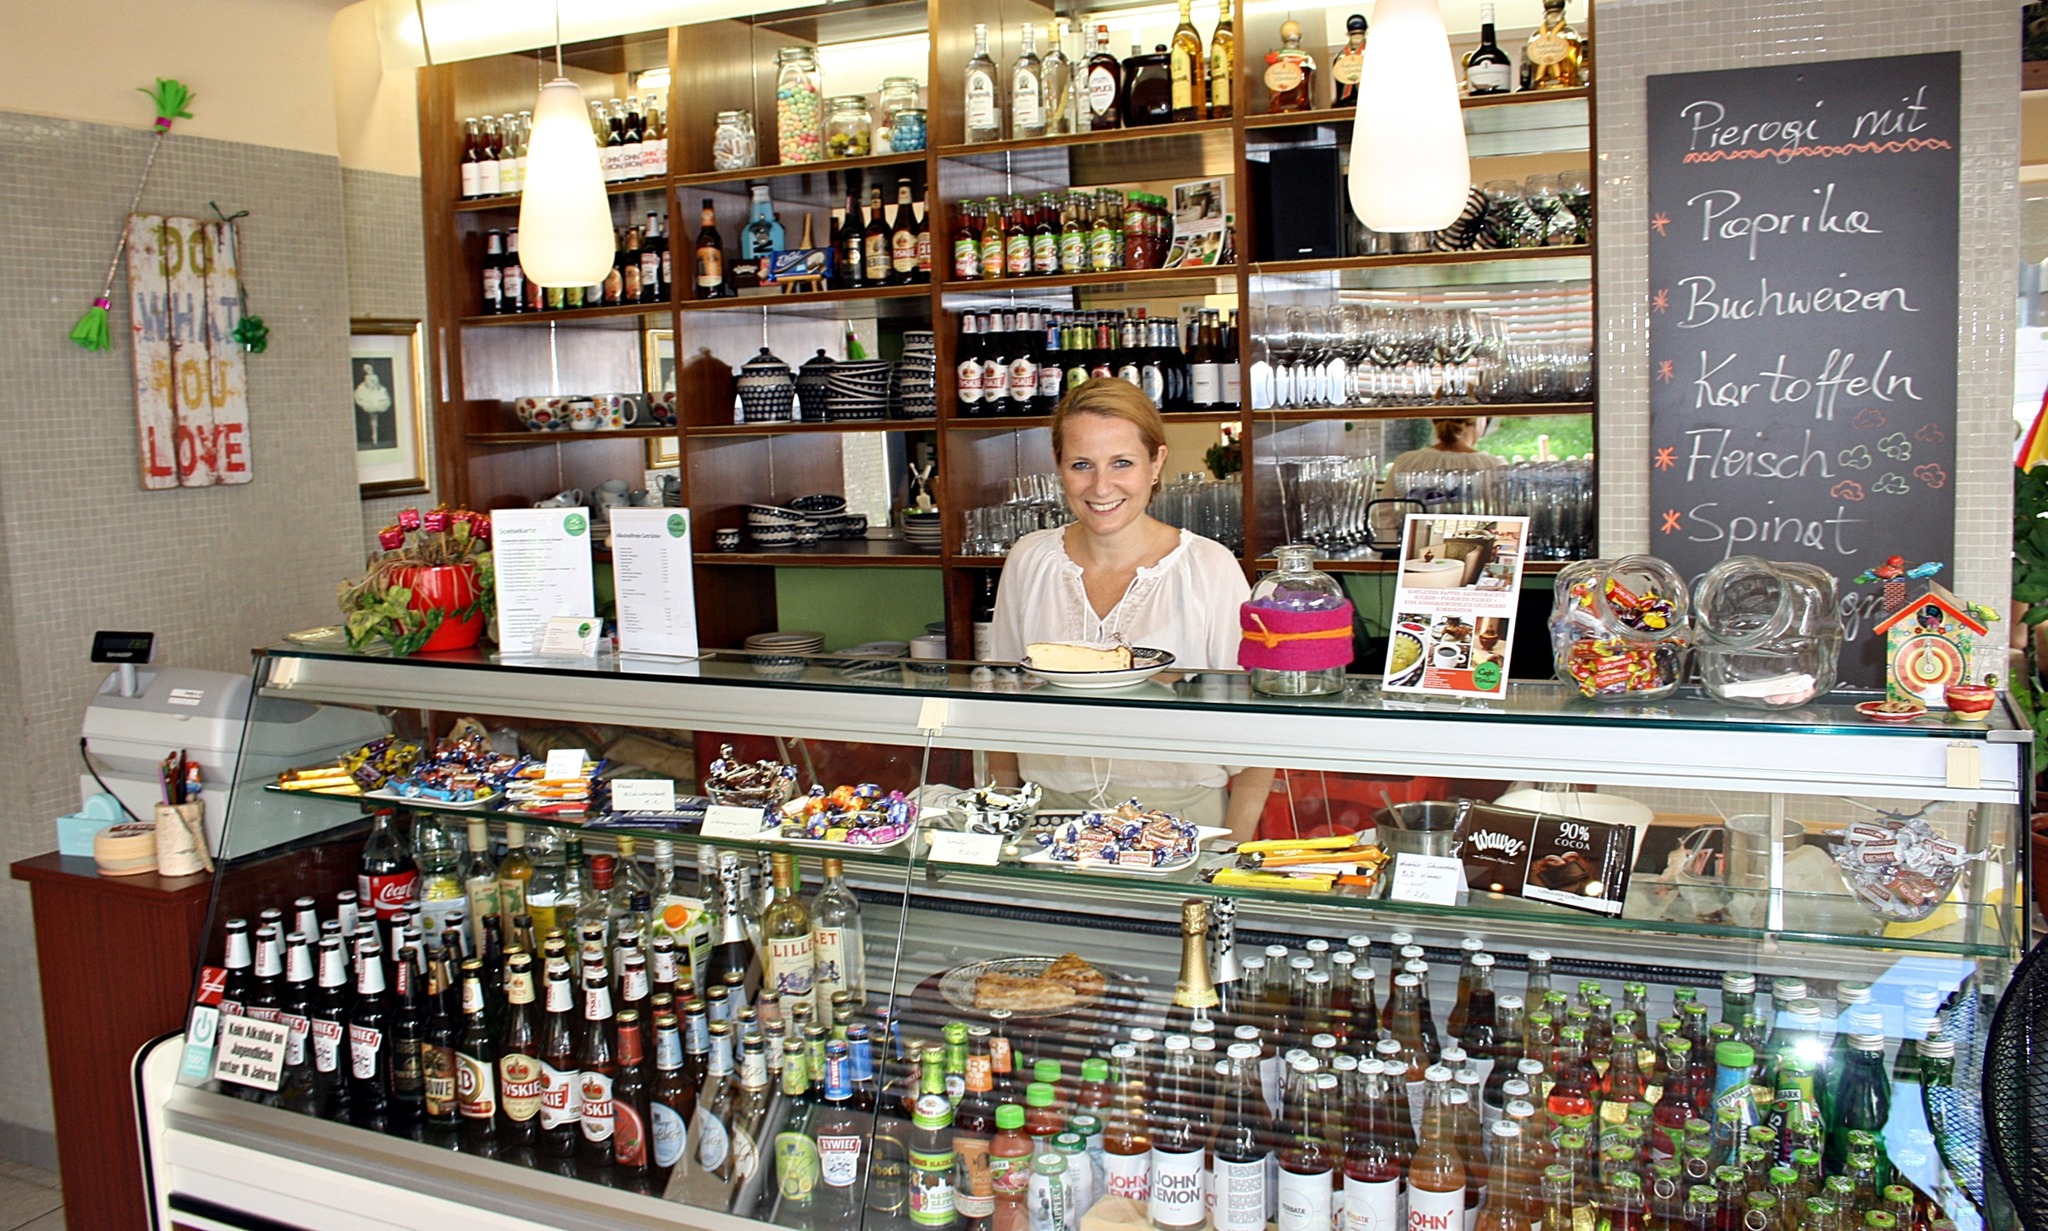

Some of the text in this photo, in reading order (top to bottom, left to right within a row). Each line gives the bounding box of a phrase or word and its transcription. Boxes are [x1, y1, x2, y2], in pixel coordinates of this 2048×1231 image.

[1680, 85, 1929, 164] Pierogi mit
[1686, 183, 1884, 261] Paprika
[156, 225, 214, 278] DO
[136, 290, 240, 343] WHAT
[1676, 272, 1921, 329] Buchweizen
[152, 359, 231, 410] YOU
[1693, 349, 1923, 421] Kartoffeln
[147, 423, 247, 478] LOVE
[1684, 429, 1835, 482] Fleisch
[1687, 500, 1869, 561] Spinat
[1468, 828, 1523, 857] Wawel
[1554, 837, 1591, 851] COCOA
[1560, 822, 1591, 842] 90%
[228, 1023, 284, 1045] Kein Alkohol an
[230, 1041, 274, 1062] Jugendliche
[219, 1060, 240, 1074] unter
[241, 1063, 250, 1077] 16
[1108, 1169, 1150, 1189] JOHN
[1154, 1168, 1199, 1189] JOHN
[1154, 1187, 1201, 1204] LEMON
